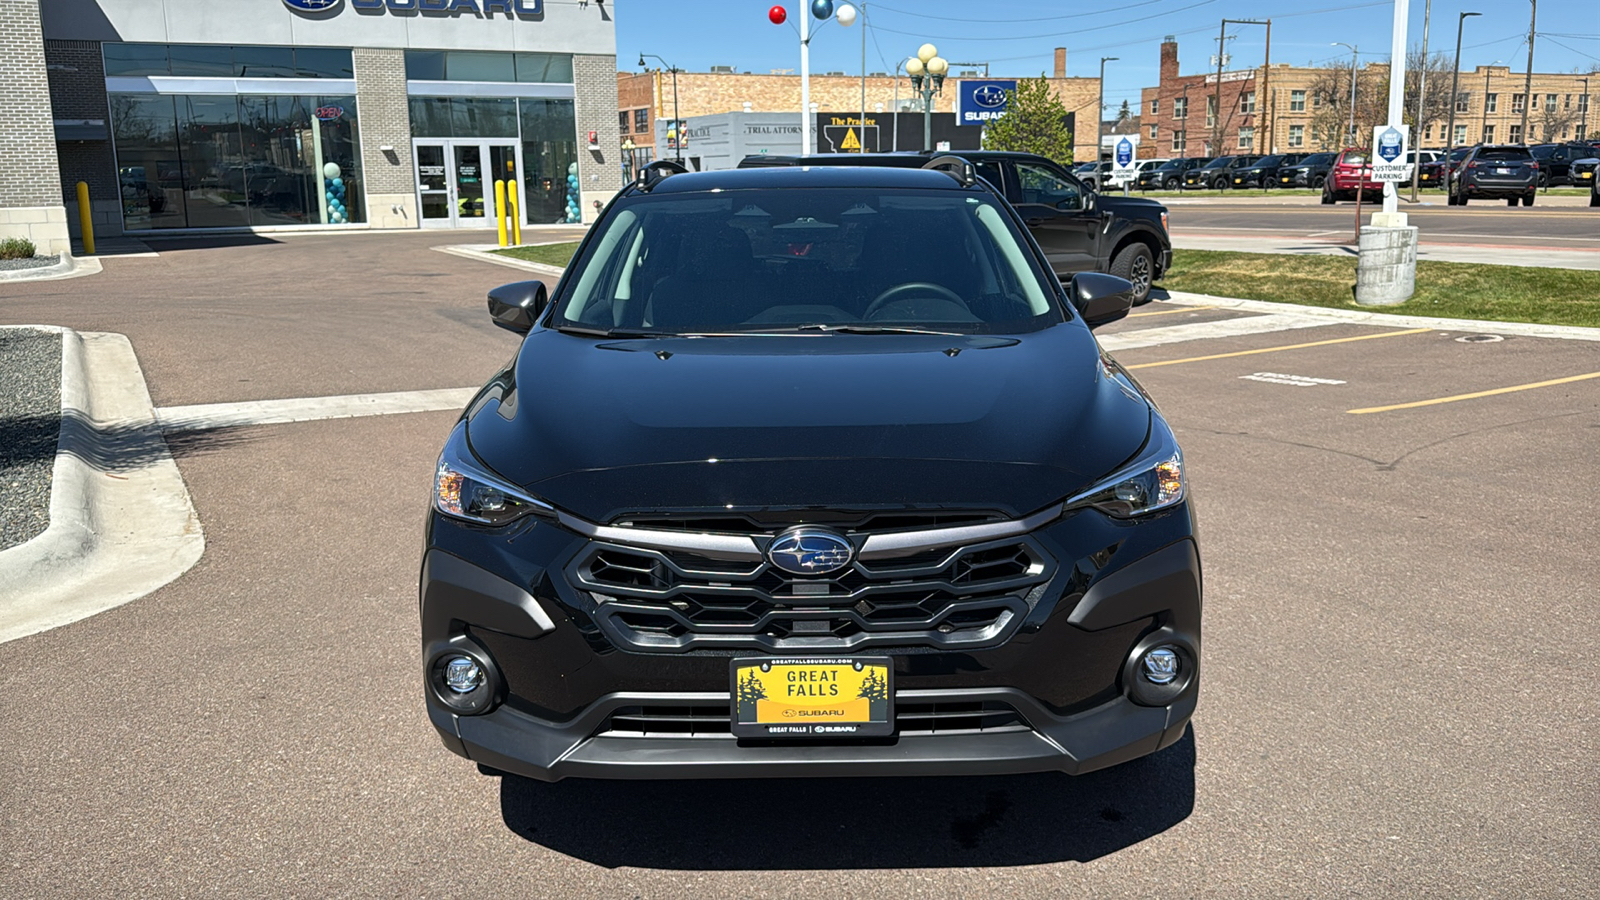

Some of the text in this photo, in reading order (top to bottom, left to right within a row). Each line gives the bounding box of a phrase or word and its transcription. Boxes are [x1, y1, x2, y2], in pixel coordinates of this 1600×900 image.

[315, 106, 342, 119] OPEN
[964, 111, 1009, 121] SUBAR
[831, 117, 876, 126] The Praice
[747, 126, 817, 134] TRIAL ATTORNYS
[787, 670, 838, 682] GREAT
[787, 684, 839, 697] FALLS
[798, 709, 845, 717] SUBARU
